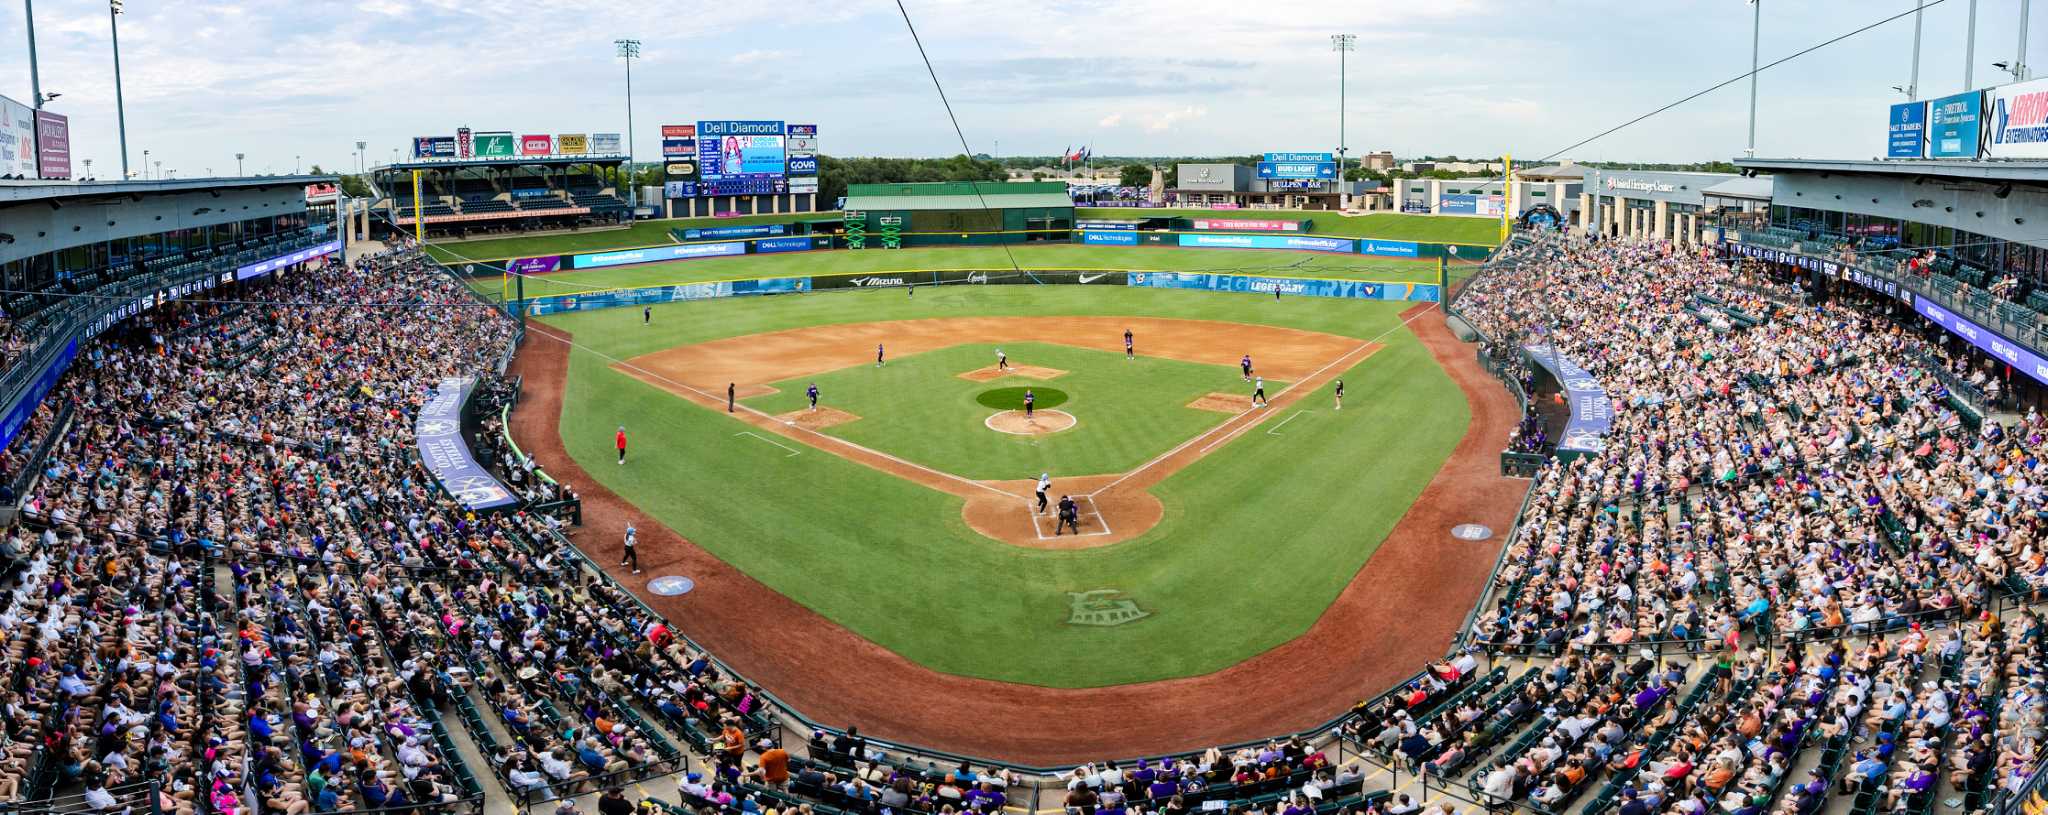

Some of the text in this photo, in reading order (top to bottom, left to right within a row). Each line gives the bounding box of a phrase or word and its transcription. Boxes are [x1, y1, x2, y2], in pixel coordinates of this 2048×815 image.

[705, 122, 727, 133] Dell
[731, 121, 779, 134] Diamond
[1272, 153, 1322, 162] Dell Diamond
[790, 161, 816, 170] GOYA
[1277, 165, 1316, 173] BUD LIGHT
[1250, 281, 1305, 293] LEGENDARY
